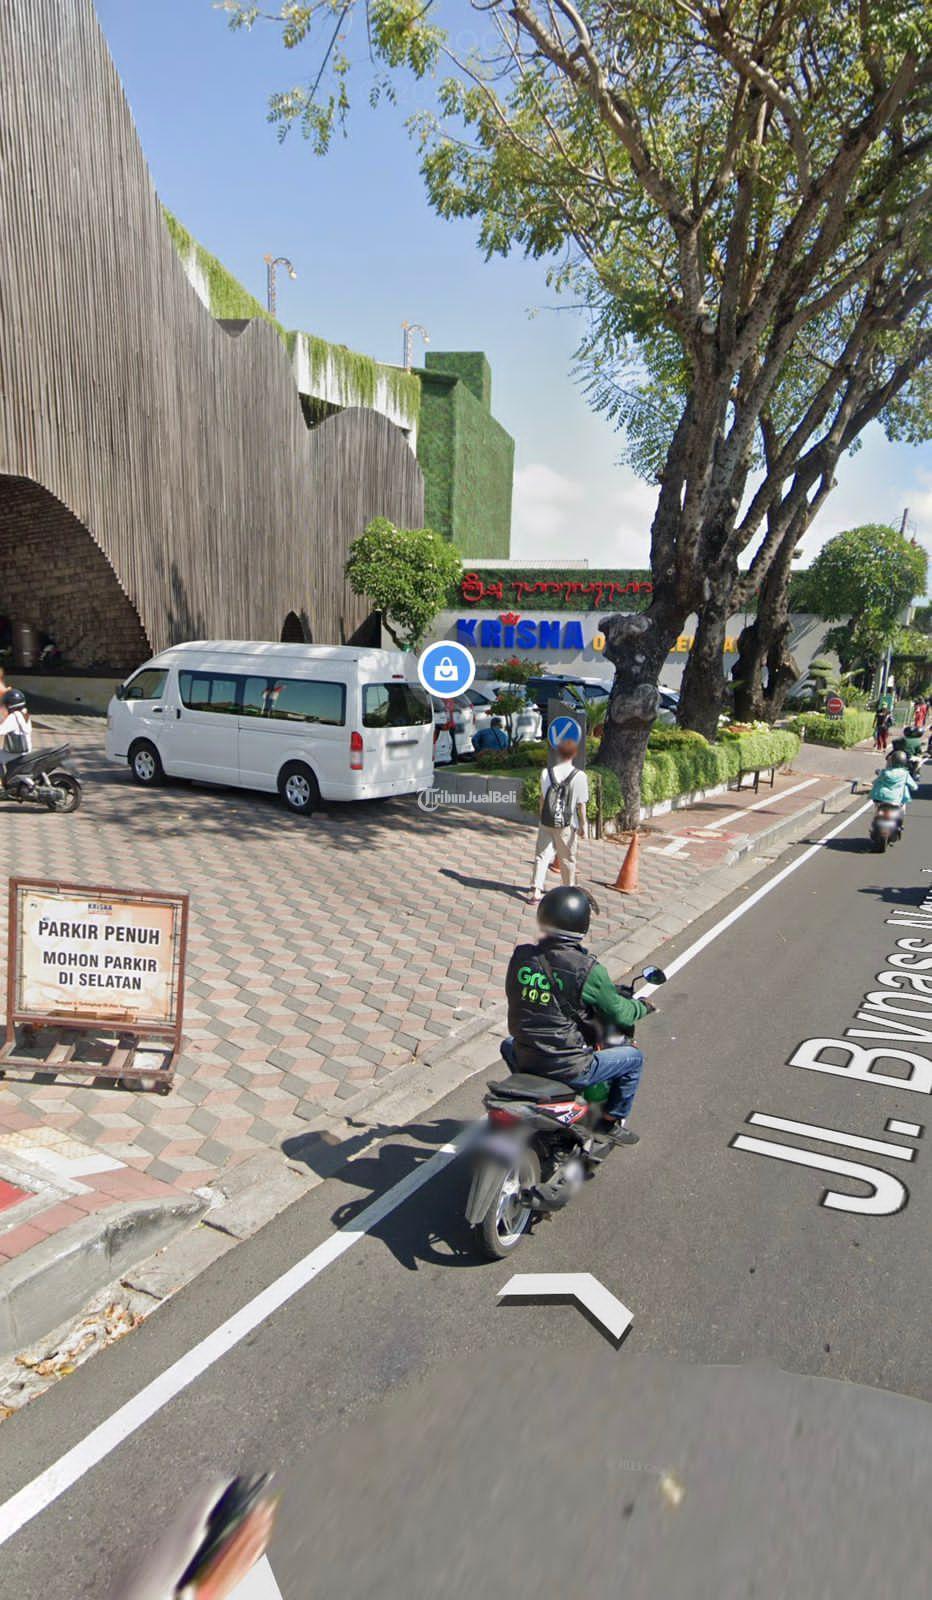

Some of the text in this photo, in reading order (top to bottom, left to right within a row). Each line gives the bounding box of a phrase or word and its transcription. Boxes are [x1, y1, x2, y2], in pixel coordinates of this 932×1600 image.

[456, 618, 585, 650] KRISNA
[38, 920, 160, 945] PARKIR PENUH
[43, 951, 157, 972] MOHON PARKIR
[59, 972, 142, 990] DI SELATAN
